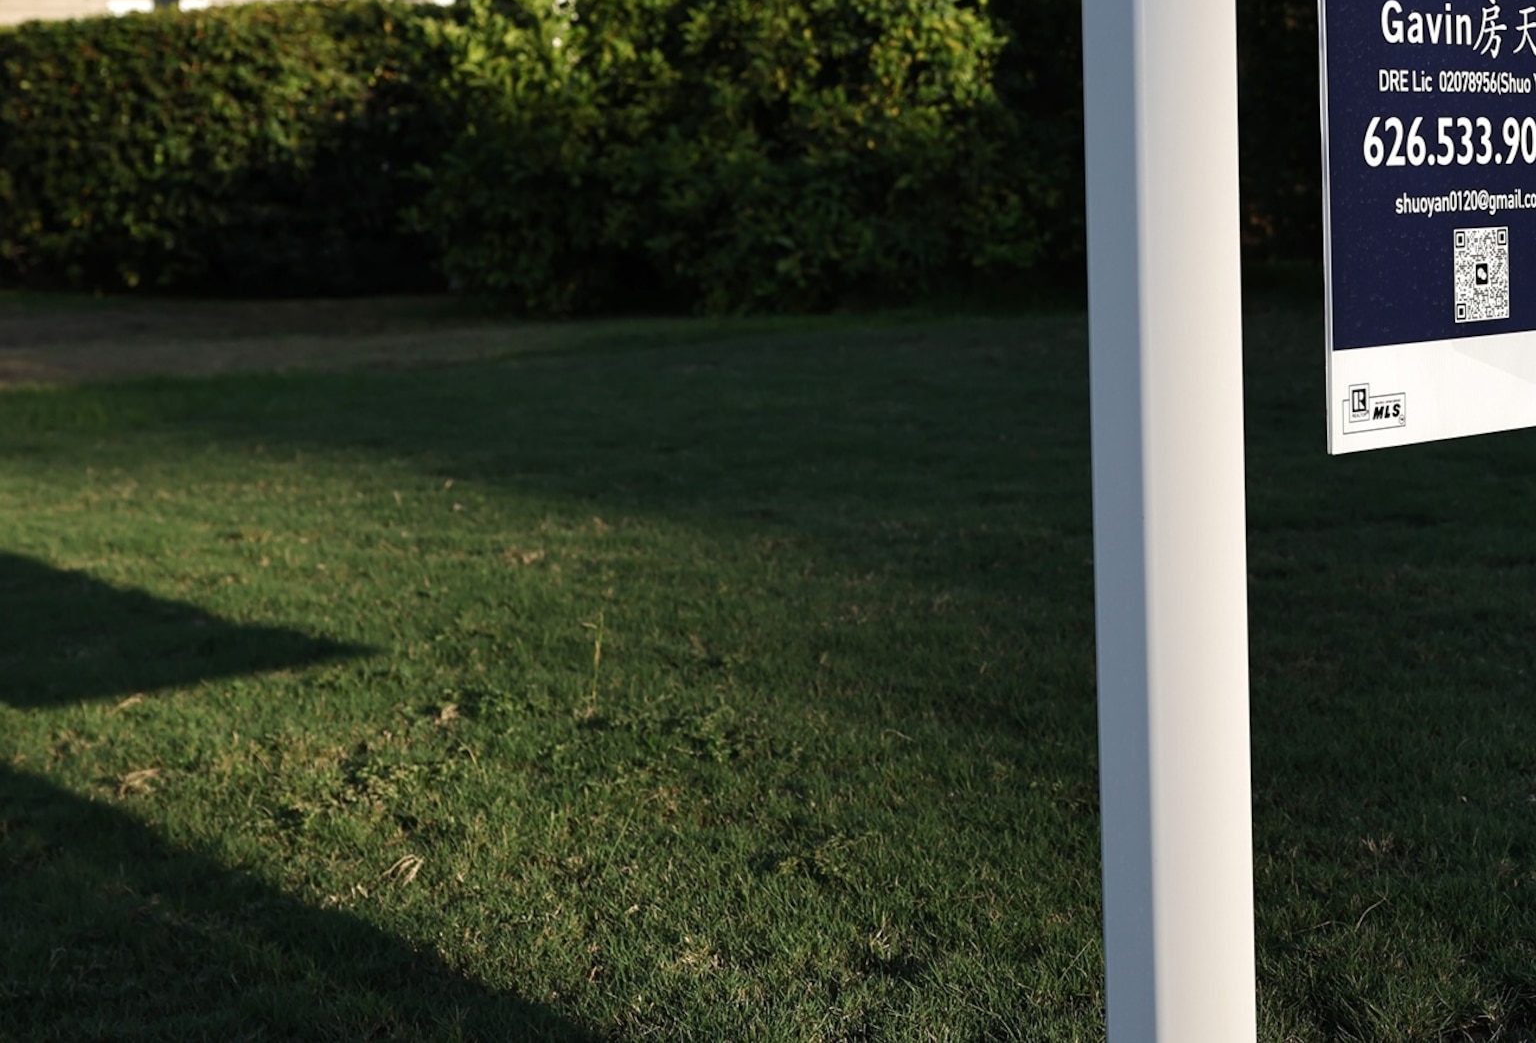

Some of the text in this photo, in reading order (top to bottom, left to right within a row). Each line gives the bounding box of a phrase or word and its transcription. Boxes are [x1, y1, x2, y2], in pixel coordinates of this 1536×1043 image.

[1380, 0, 1472, 46] Gavin
[1378, 69, 1409, 92] DRE
[1412, 70, 1432, 92] Lic
[1372, 403, 1401, 420] MLS
